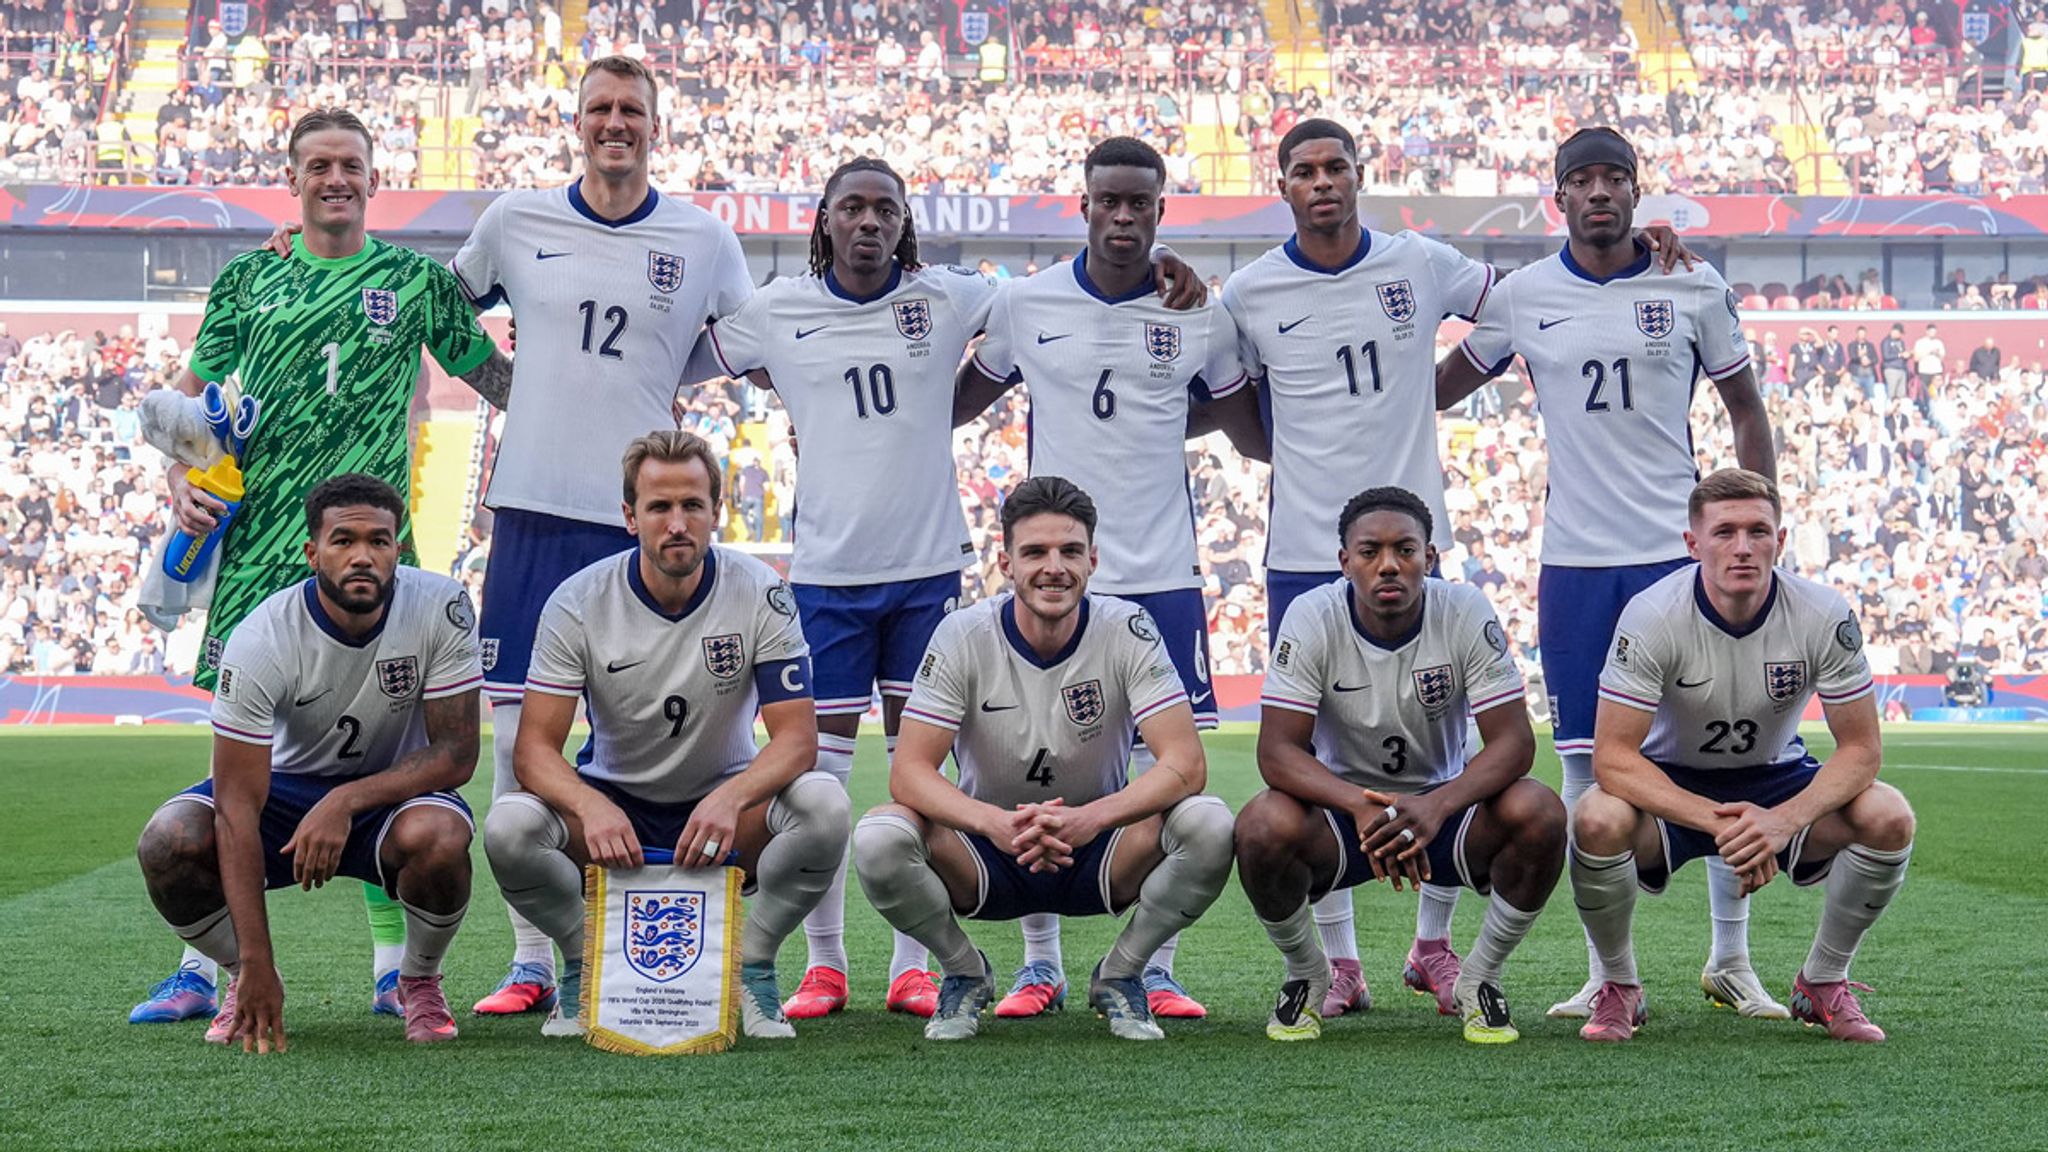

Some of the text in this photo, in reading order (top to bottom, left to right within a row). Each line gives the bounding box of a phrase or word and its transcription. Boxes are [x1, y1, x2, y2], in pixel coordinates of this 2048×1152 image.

[711, 195, 1010, 232] ON EAND!
[579, 300, 628, 360] 12
[320, 342, 340, 396] 1
[1336, 340, 1383, 396] 11
[1582, 358, 1634, 413] 21
[844, 363, 898, 419] 10
[1092, 368, 1117, 422] 6
[780, 664, 804, 692] C
[664, 695, 689, 738] 9
[337, 715, 363, 759] 2
[1382, 735, 1407, 775] 3
[1699, 719, 1759, 755] 23
[1026, 748, 1055, 788] 4
[635, 986, 657, 995] England
[639, 997, 650, 1005] Cup
[667, 998, 693, 1007] Qualifying
[695, 999, 712, 1007] Round
[619, 1018, 643, 1026] Saturday
[655, 1019, 683, 1028] September
[657, 1009, 689, 1017] Birmingham
